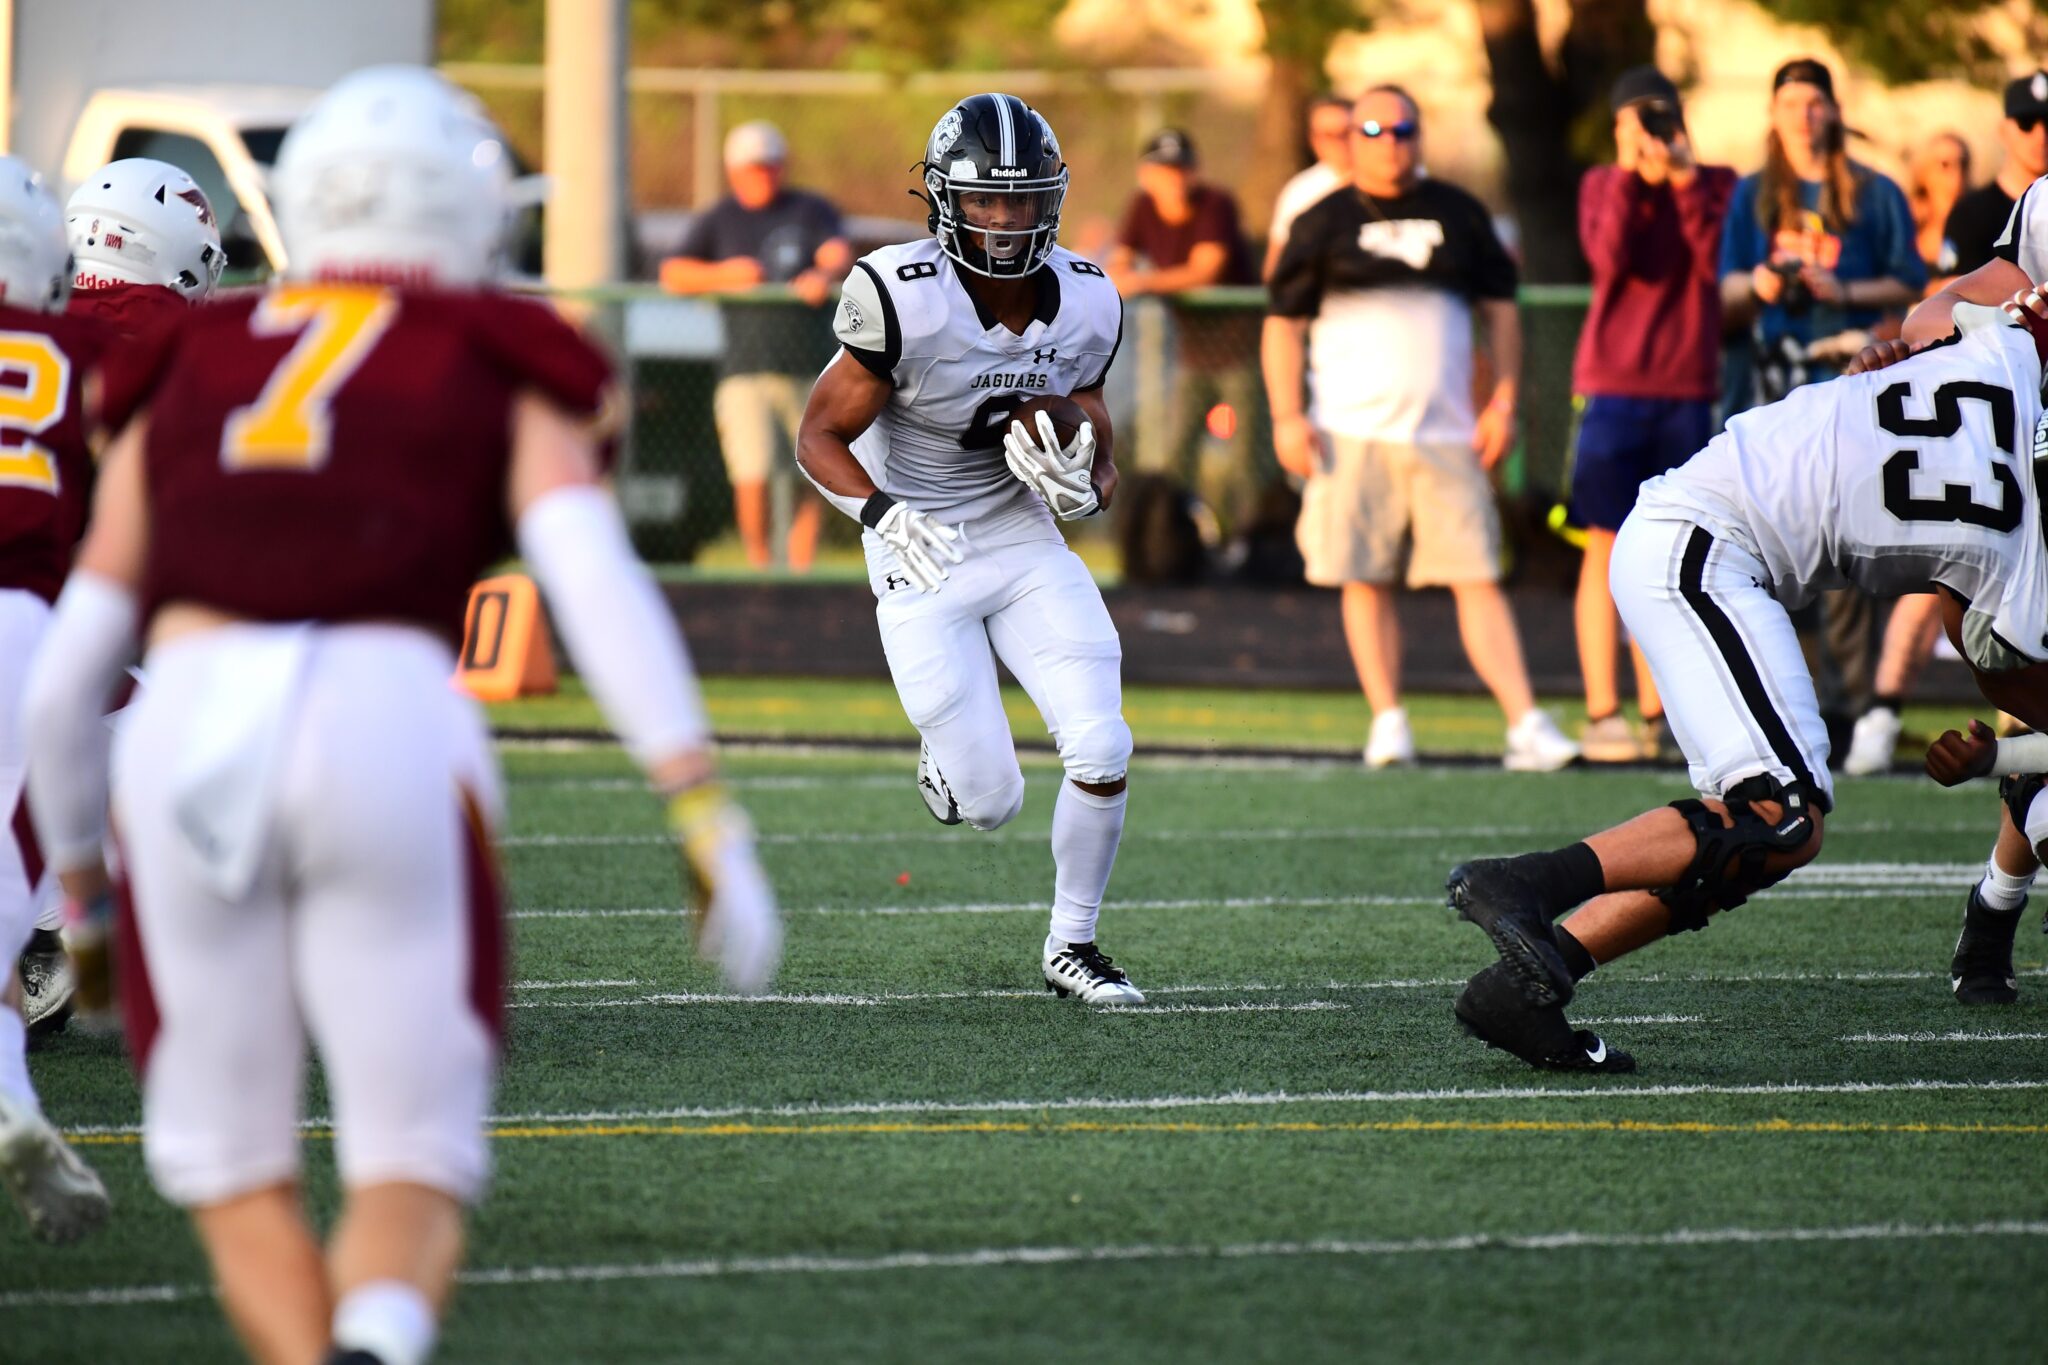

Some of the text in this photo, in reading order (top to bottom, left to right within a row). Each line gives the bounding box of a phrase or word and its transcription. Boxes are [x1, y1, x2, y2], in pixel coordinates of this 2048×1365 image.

[991, 168, 1028, 178] Riddell
[896, 261, 938, 282] 8
[220, 282, 400, 471] 7
[971, 373, 1048, 389] JAGUARS
[1875, 379, 2025, 535] 53
[464, 591, 510, 671] 0
